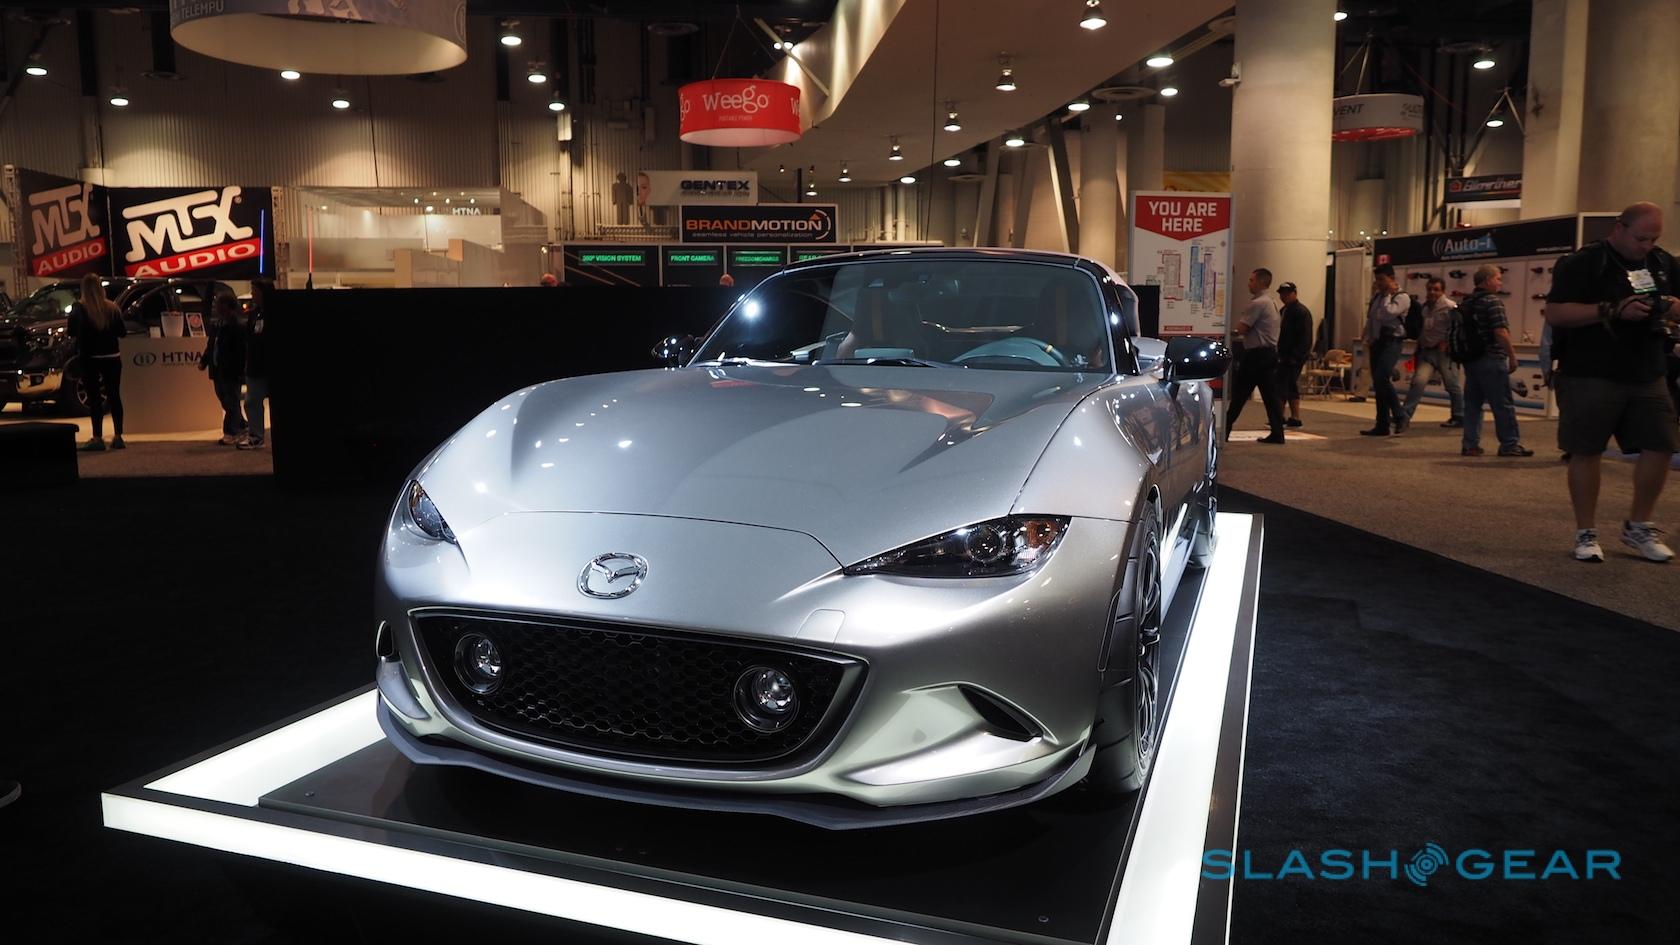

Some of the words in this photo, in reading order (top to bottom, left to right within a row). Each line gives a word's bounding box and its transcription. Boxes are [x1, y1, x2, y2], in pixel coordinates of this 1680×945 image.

[702, 84, 769, 114] Weego
[681, 180, 750, 191] GENTEX
[452, 207, 481, 216] HTNA
[1149, 201, 1181, 216] YOU
[1186, 202, 1218, 217] ARE
[28, 183, 101, 256] MTX
[122, 185, 254, 262] MTX
[686, 219, 823, 231] BRANDMOTION
[1161, 217, 1203, 233] HERE
[756, 231, 813, 239] personalization
[37, 241, 104, 276] AUDIO
[135, 243, 257, 278] AUDIO
[617, 254, 642, 262] SYSTEM
[670, 254, 690, 262] FRONT
[690, 254, 715, 262] CAMERA
